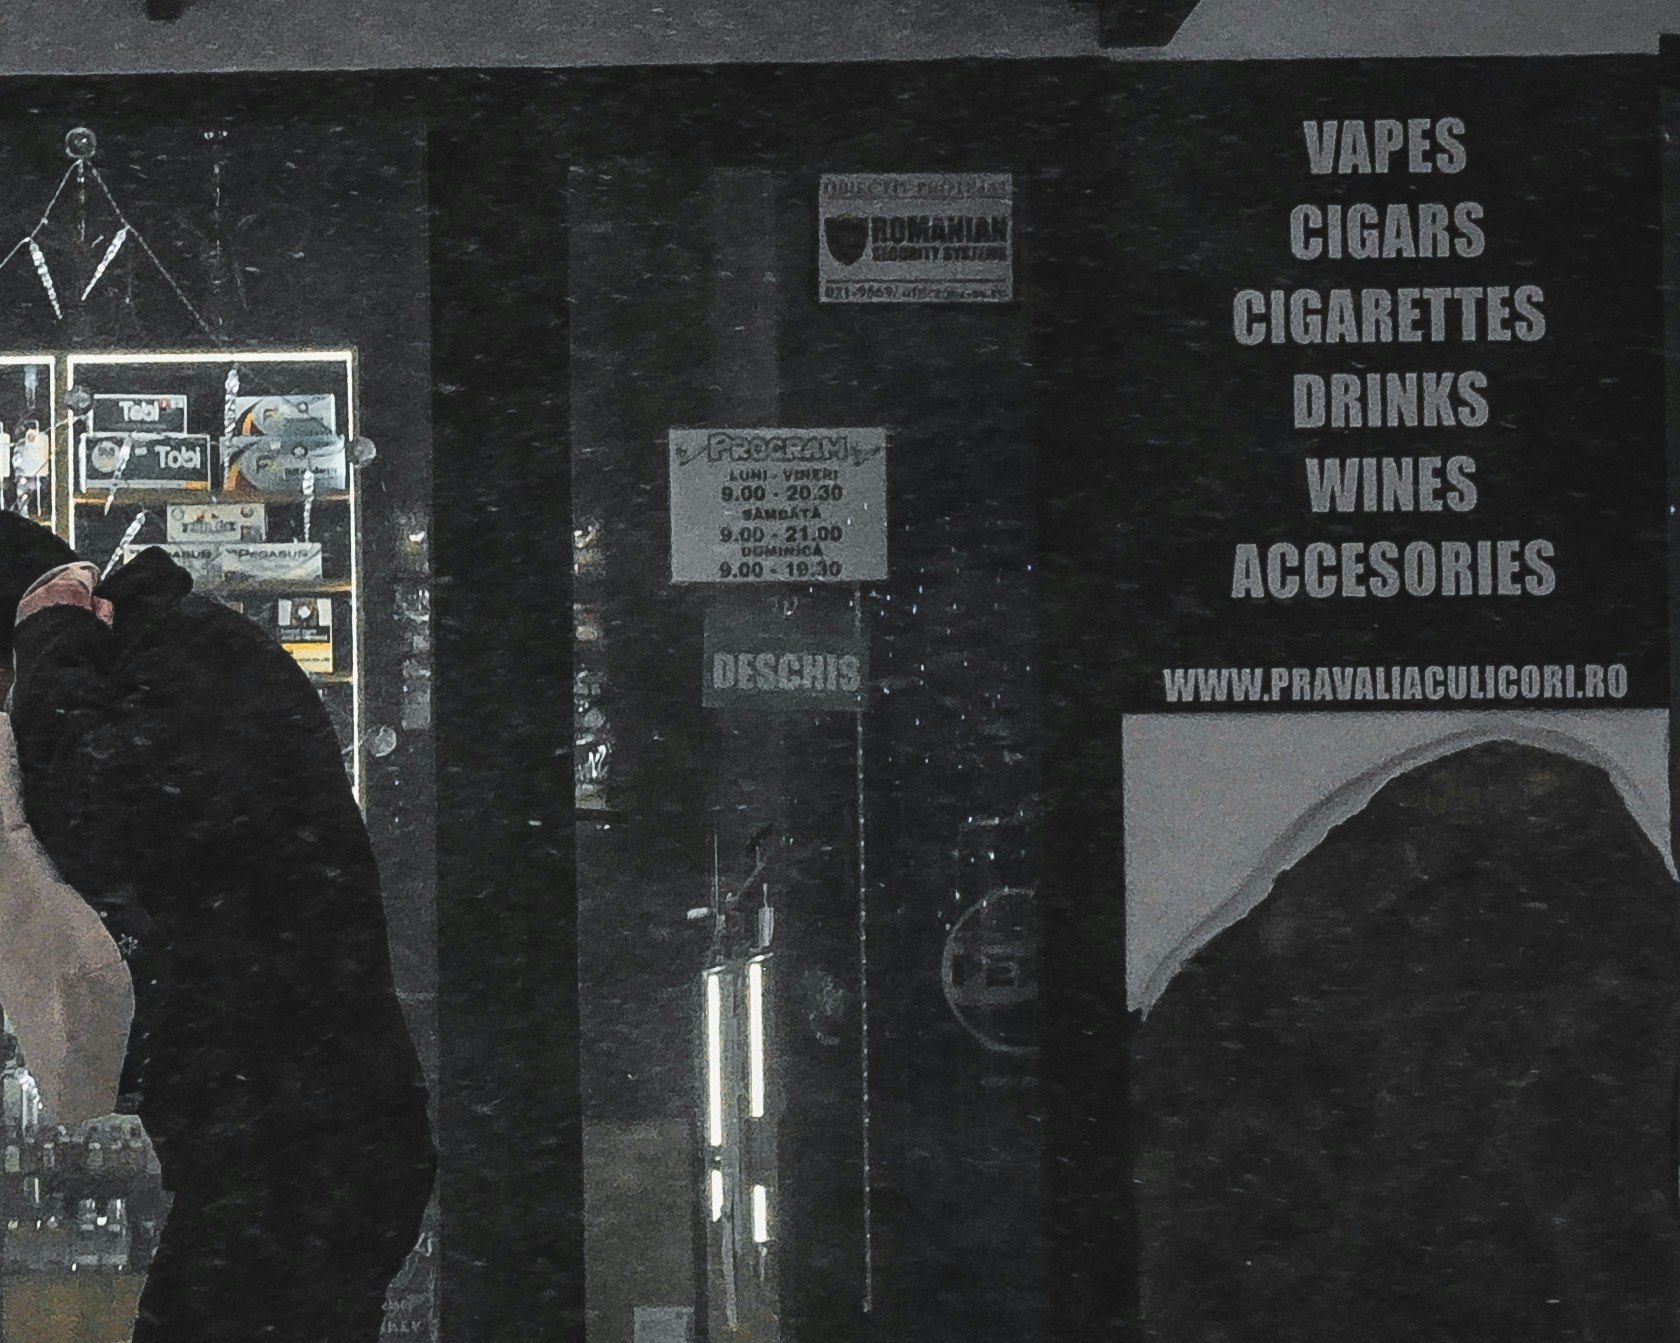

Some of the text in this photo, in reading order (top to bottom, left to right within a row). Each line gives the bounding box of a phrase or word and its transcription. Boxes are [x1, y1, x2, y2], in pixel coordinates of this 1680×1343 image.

[1302, 116, 1468, 175] VAPES
[871, 215, 1008, 244] ROMANIAN
[1289, 201, 1486, 261] CIGARS
[1233, 285, 1547, 346] CIGARETTES
[1293, 370, 1490, 429] DRINKS
[154, 445, 201, 469] Tobi
[707, 432, 848, 463] PROGRAM
[721, 485, 766, 502] 9.00
[785, 484, 843, 502] 20.30
[1304, 455, 1478, 513] WINES
[720, 526, 765, 543] 9.00
[785, 525, 843, 542] 21.00
[1230, 538, 1557, 600] ACCESORIES
[713, 652, 861, 692] DESCHIS
[1162, 663, 1629, 703] WWW.PRAVALIACULICORI.RO
